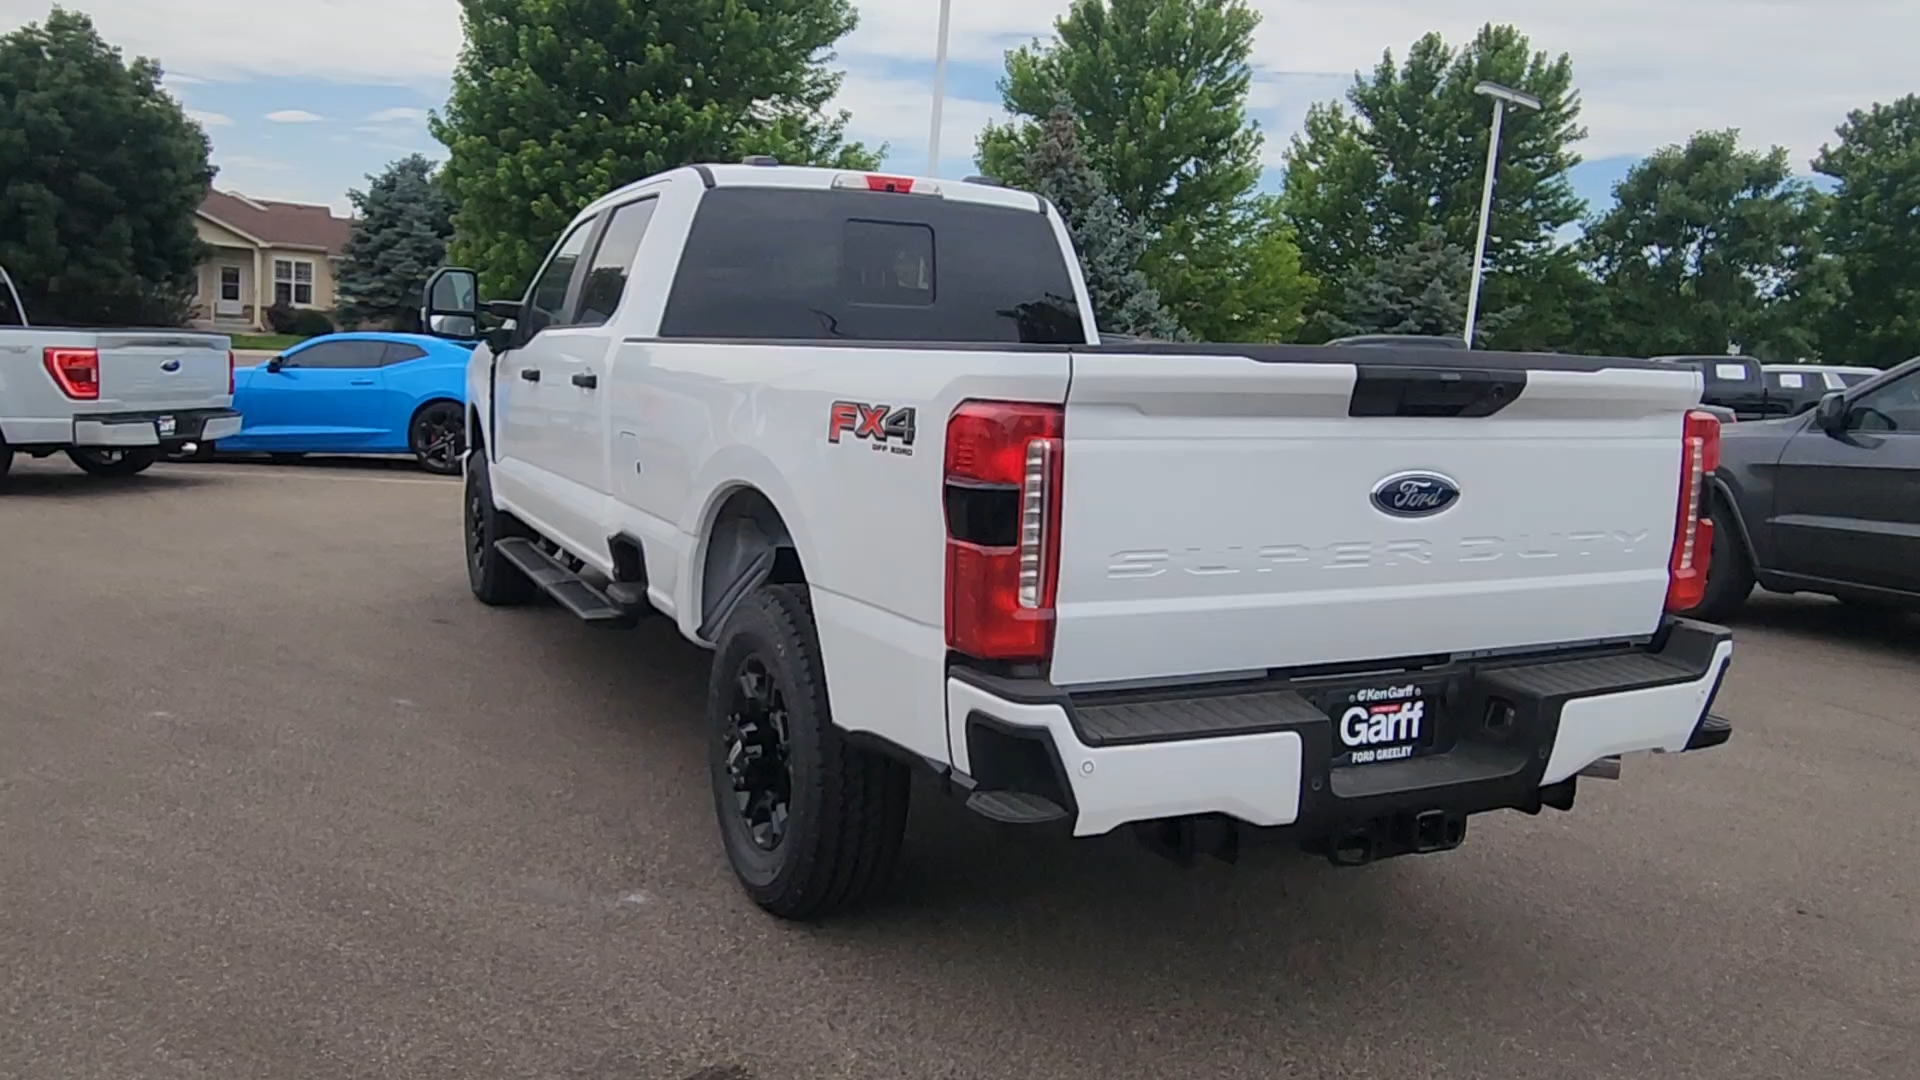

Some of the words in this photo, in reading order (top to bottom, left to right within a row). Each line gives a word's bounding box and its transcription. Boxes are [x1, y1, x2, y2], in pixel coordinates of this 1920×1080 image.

[828, 400, 916, 446] FX4
[872, 444, 888, 452] OFF
[890, 446, 913, 456] ROAD
[1393, 480, 1443, 507] Ford
[1107, 539, 1432, 578] SUPER
[1458, 528, 1649, 562] DUTY
[1366, 689, 1388, 701] Ken
[1388, 684, 1414, 699] Garff
[1340, 701, 1424, 746] Garff
[1352, 750, 1375, 764] FORD
[1376, 746, 1413, 760] GREELEY
